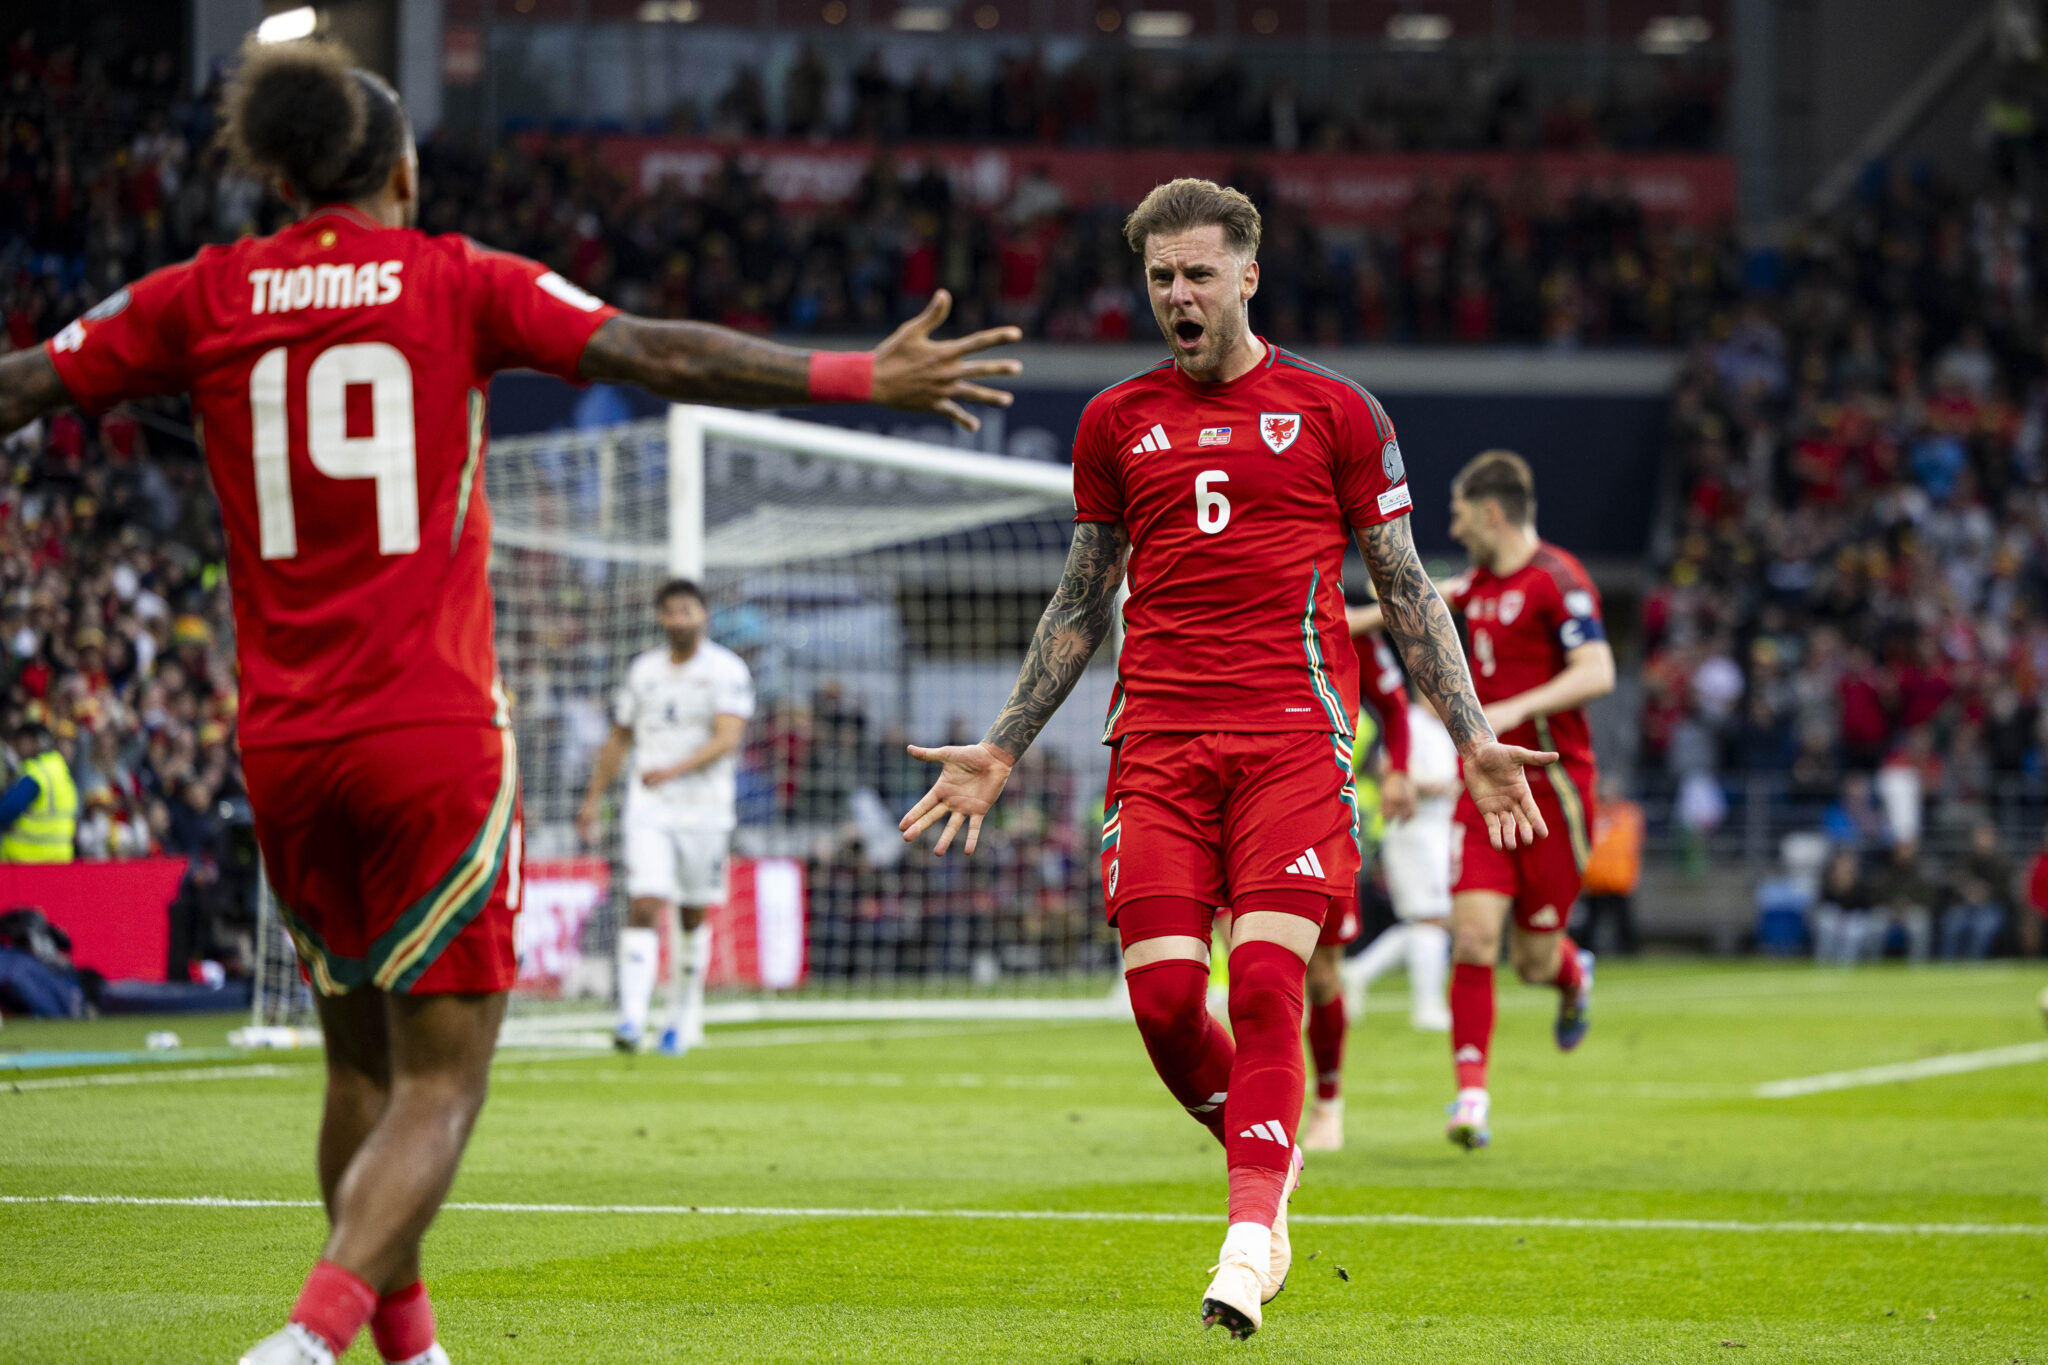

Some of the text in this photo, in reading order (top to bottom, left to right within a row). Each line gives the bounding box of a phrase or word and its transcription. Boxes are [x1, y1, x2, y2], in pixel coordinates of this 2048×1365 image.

[248, 260, 404, 315] THOMAS
[249, 342, 421, 560] 19
[1195, 469, 1231, 534] 6
